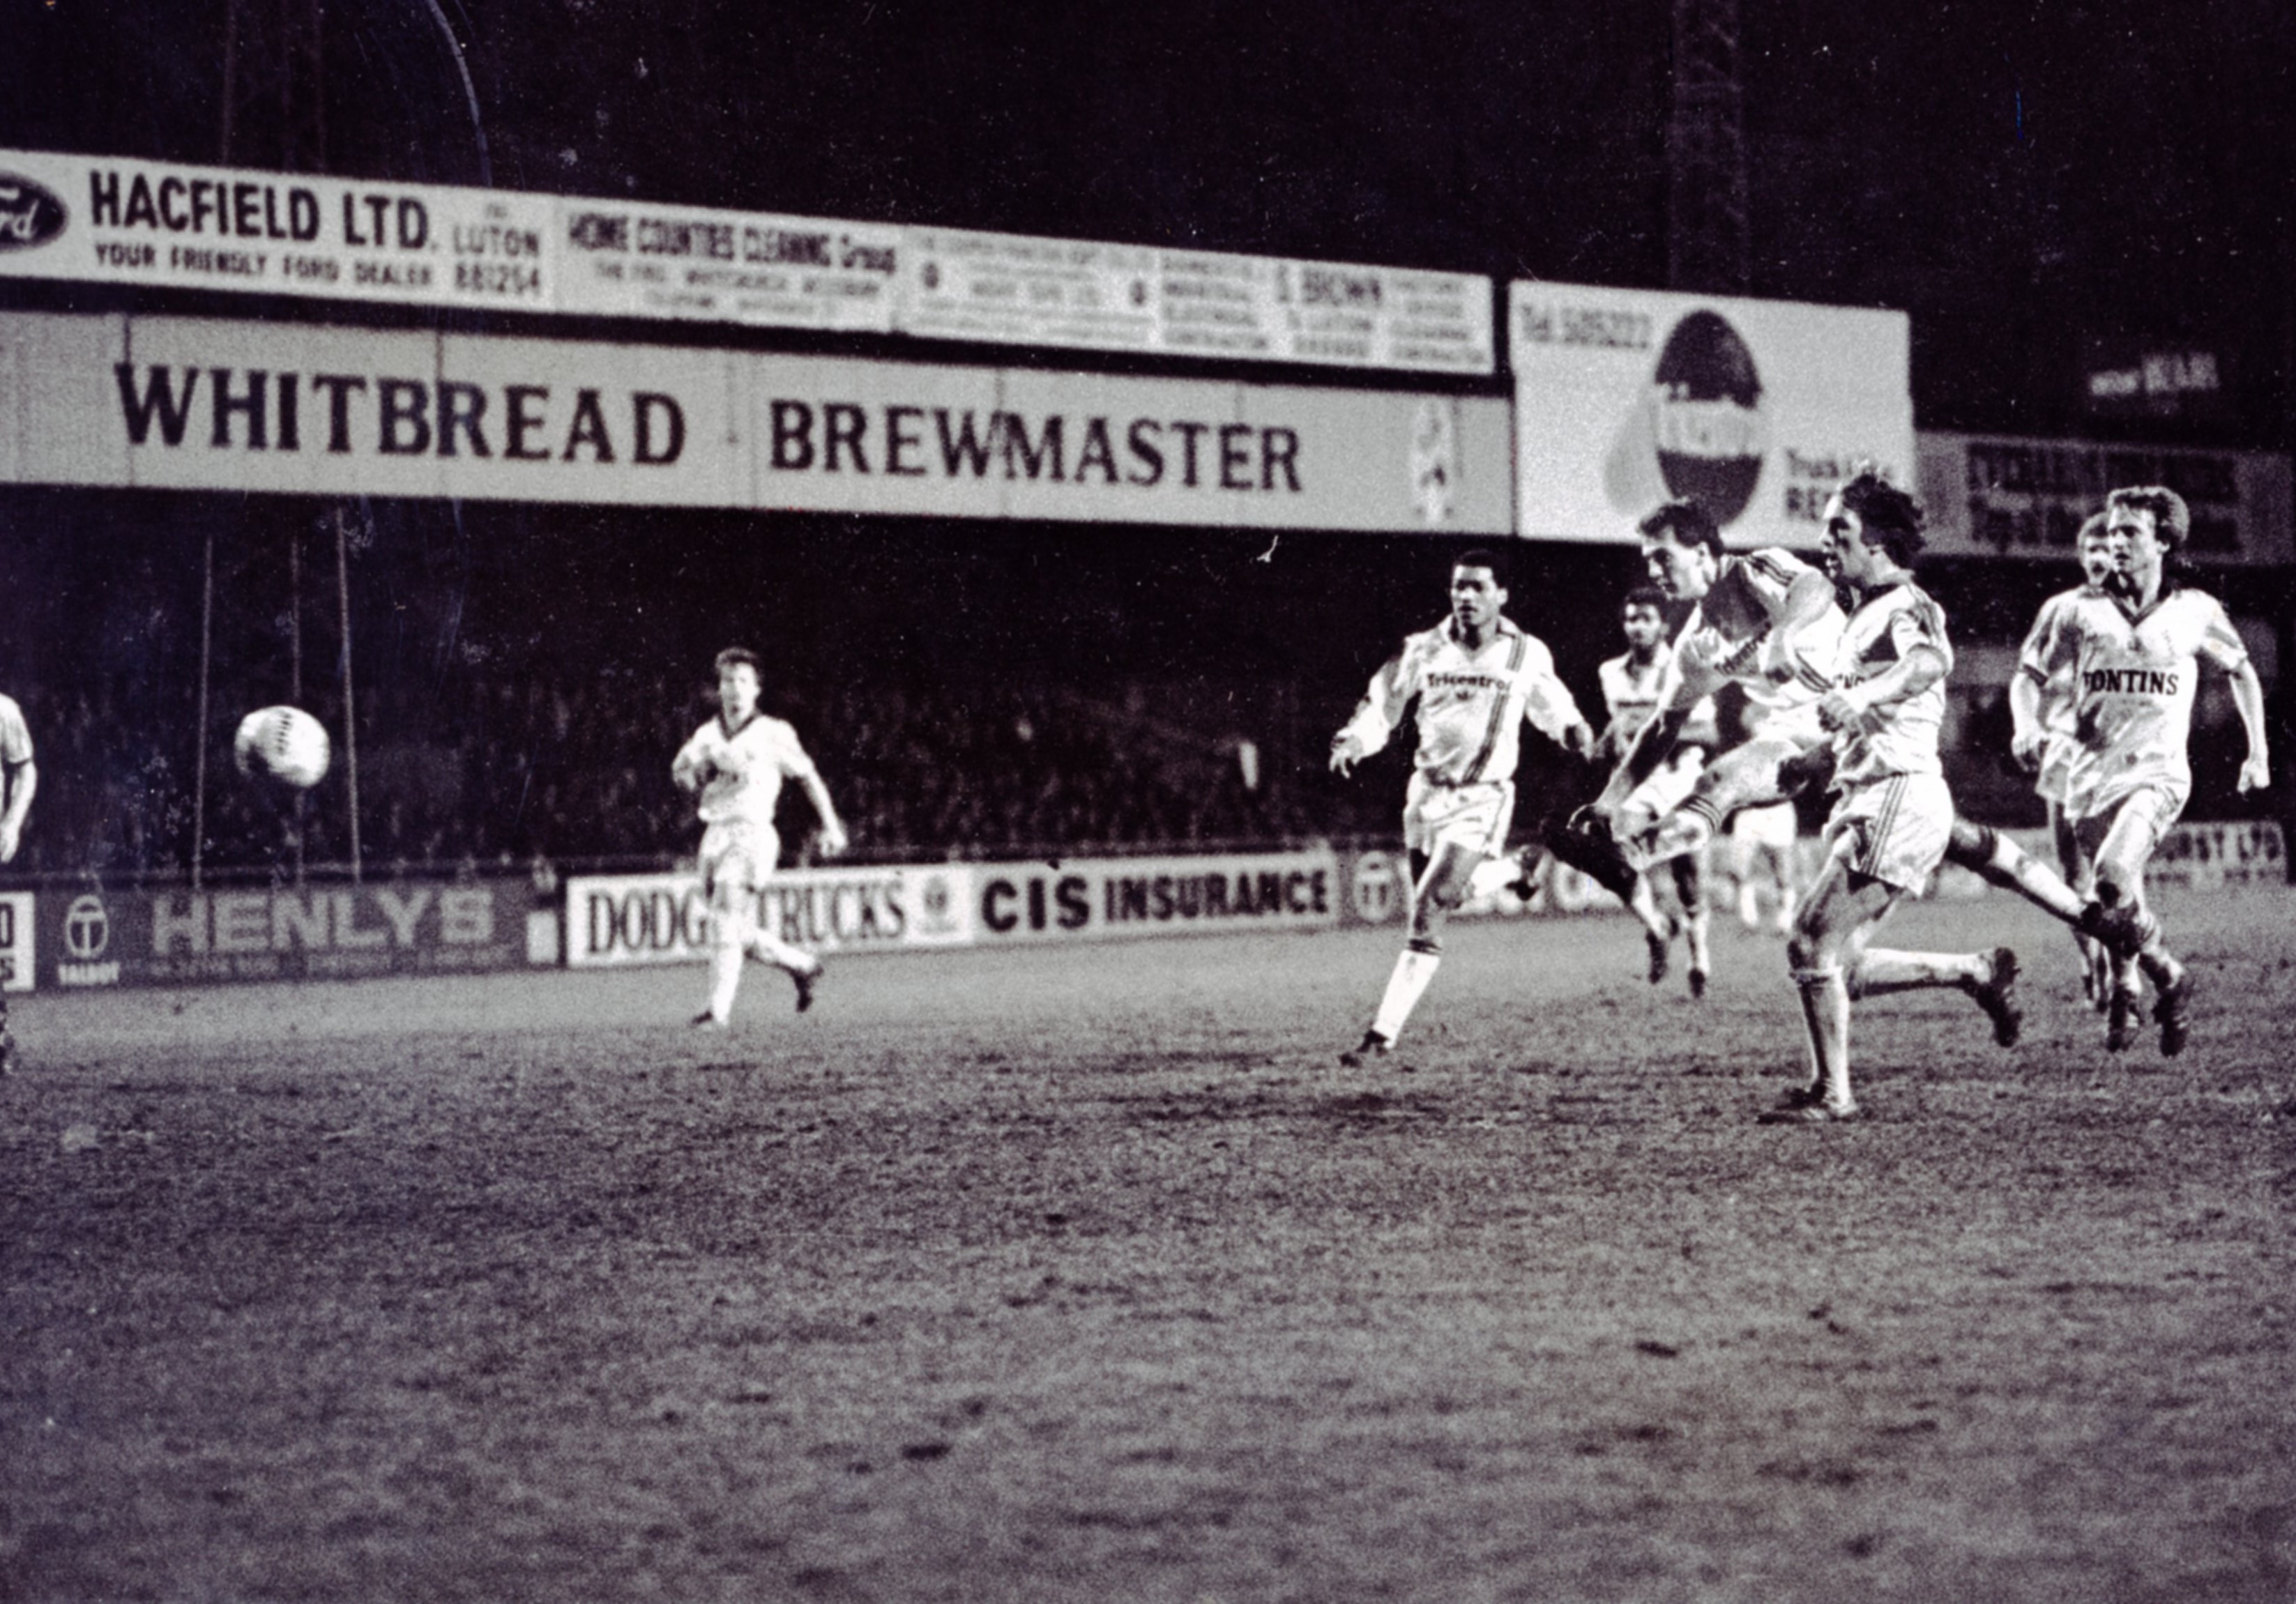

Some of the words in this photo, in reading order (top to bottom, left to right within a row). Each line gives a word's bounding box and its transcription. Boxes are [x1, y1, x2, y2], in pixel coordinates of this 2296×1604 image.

[90, 169, 321, 241] HACFIELD
[342, 190, 439, 251] LTD.
[452, 226, 540, 258] LUTON
[95, 243, 155, 267] YOUR
[171, 247, 267, 277] FRIENDLY
[282, 257, 340, 282] FORD
[354, 261, 433, 288] DEALER
[114, 362, 686, 466] WHITBREAD
[769, 397, 1302, 492] BREWMASTER
[151, 889, 496, 955] HENLYS
[587, 887, 710, 954] DODG
[981, 876, 1090, 931] CIS
[1105, 869, 1329, 922] INSURANCE
